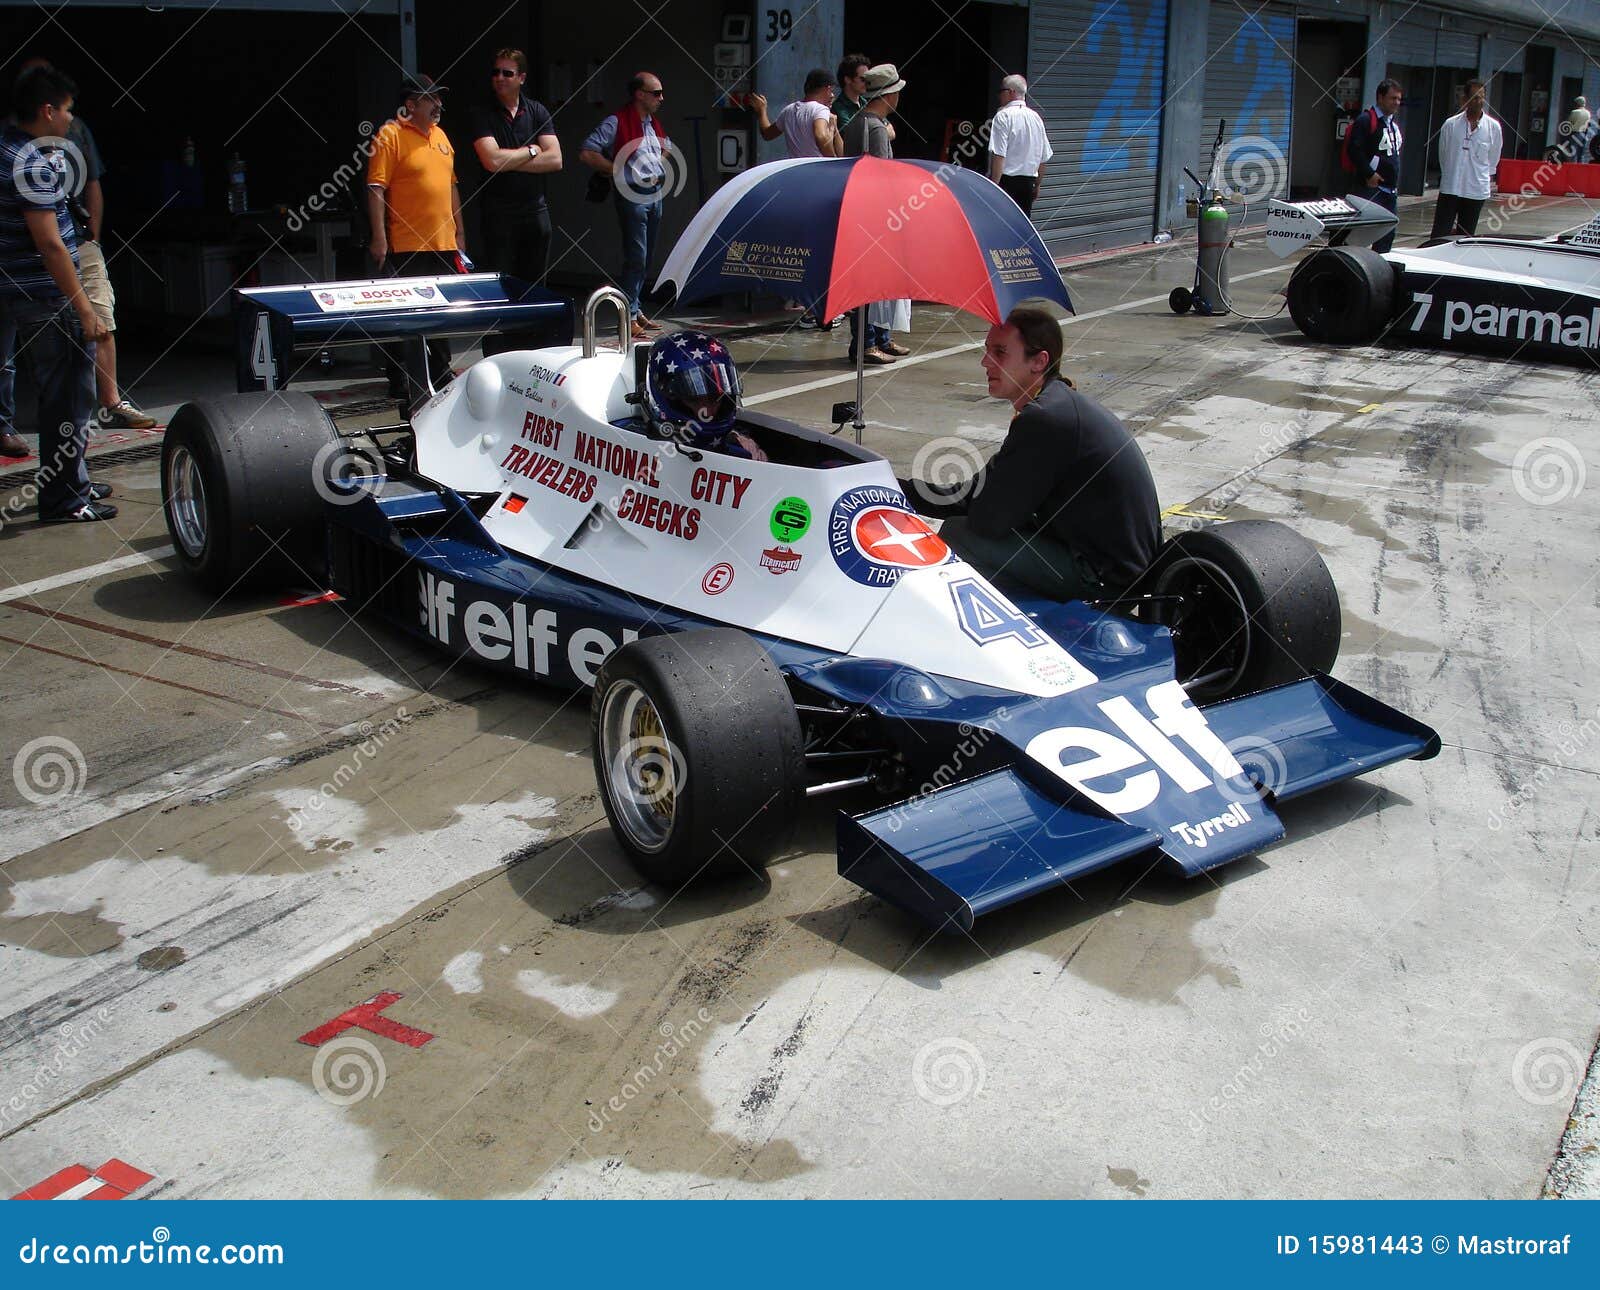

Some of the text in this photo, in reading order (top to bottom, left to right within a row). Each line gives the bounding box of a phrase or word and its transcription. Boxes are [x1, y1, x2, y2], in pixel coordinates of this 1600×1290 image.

[766, 9, 792, 42] 39
[1267, 207, 1306, 220] PEMEX
[750, 243, 812, 257] ROYAL BANK
[1266, 229, 1312, 240] GOODYEAR
[747, 253, 804, 267] OF CANADA
[361, 289, 412, 299] BOSCH
[1410, 292, 1600, 349] 7 parmal
[251, 311, 278, 391] 4
[528, 364, 556, 384] PIRONI
[521, 410, 752, 510] FIRST NATIONAL CITY
[500, 444, 701, 541] TRAVELERS CHECKS
[783, 527, 790, 536] 3
[832, 489, 912, 556] FIRST NATIONAL
[760, 555, 800, 572] VERIFICATO
[948, 577, 1049, 649] 4
[464, 600, 558, 676] elf
[1025, 679, 1245, 815] elf
[1169, 801, 1252, 848] Tyrrell
